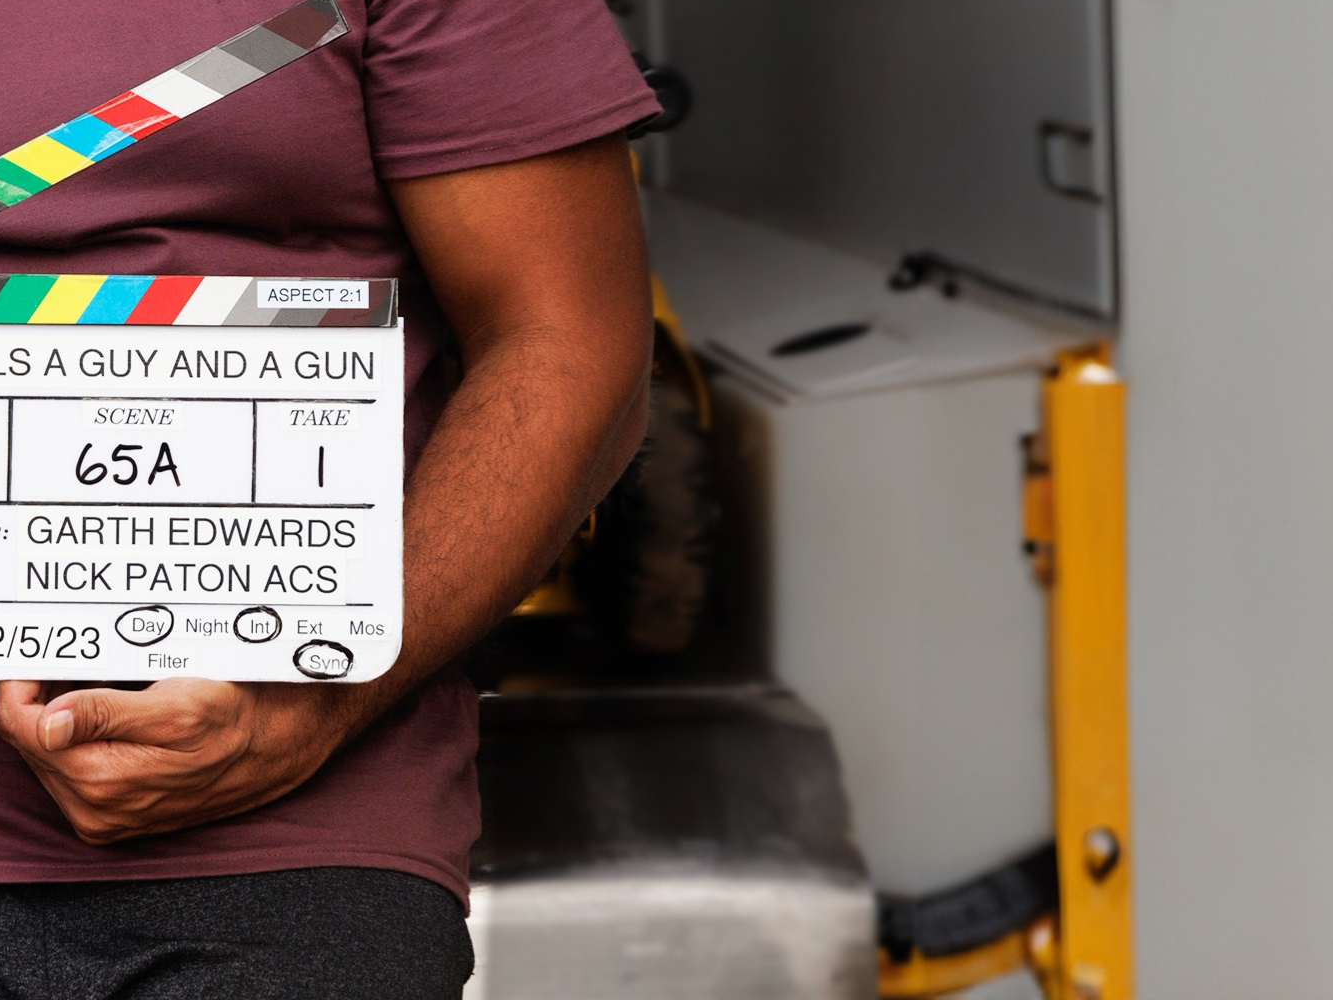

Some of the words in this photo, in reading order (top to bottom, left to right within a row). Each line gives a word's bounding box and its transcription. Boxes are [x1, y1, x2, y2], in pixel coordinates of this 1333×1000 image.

[268, 288, 334, 302] ASPECT
[340, 289, 360, 302] 2:1
[44, 349, 66, 376] A
[79, 349, 158, 377] GUY
[170, 350, 247, 378] AND
[259, 351, 282, 378] A
[295, 351, 373, 379] GUN
[94, 408, 174, 425] SCENE
[291, 410, 350, 425] TAKE
[76, 442, 181, 487] 65A
[28, 516, 153, 545] GARTH
[169, 518, 355, 548] EDWARDS
[27, 562, 112, 590] NICK
[127, 563, 250, 592] PATON
[264, 565, 337, 593] ACS
[132, 617, 165, 635] Day
[186, 619, 228, 636] Night
[250, 619, 270, 634] Int
[298, 620, 322, 634] Ext
[350, 621, 384, 635] Mos
[149, 654, 188, 668] Filter
